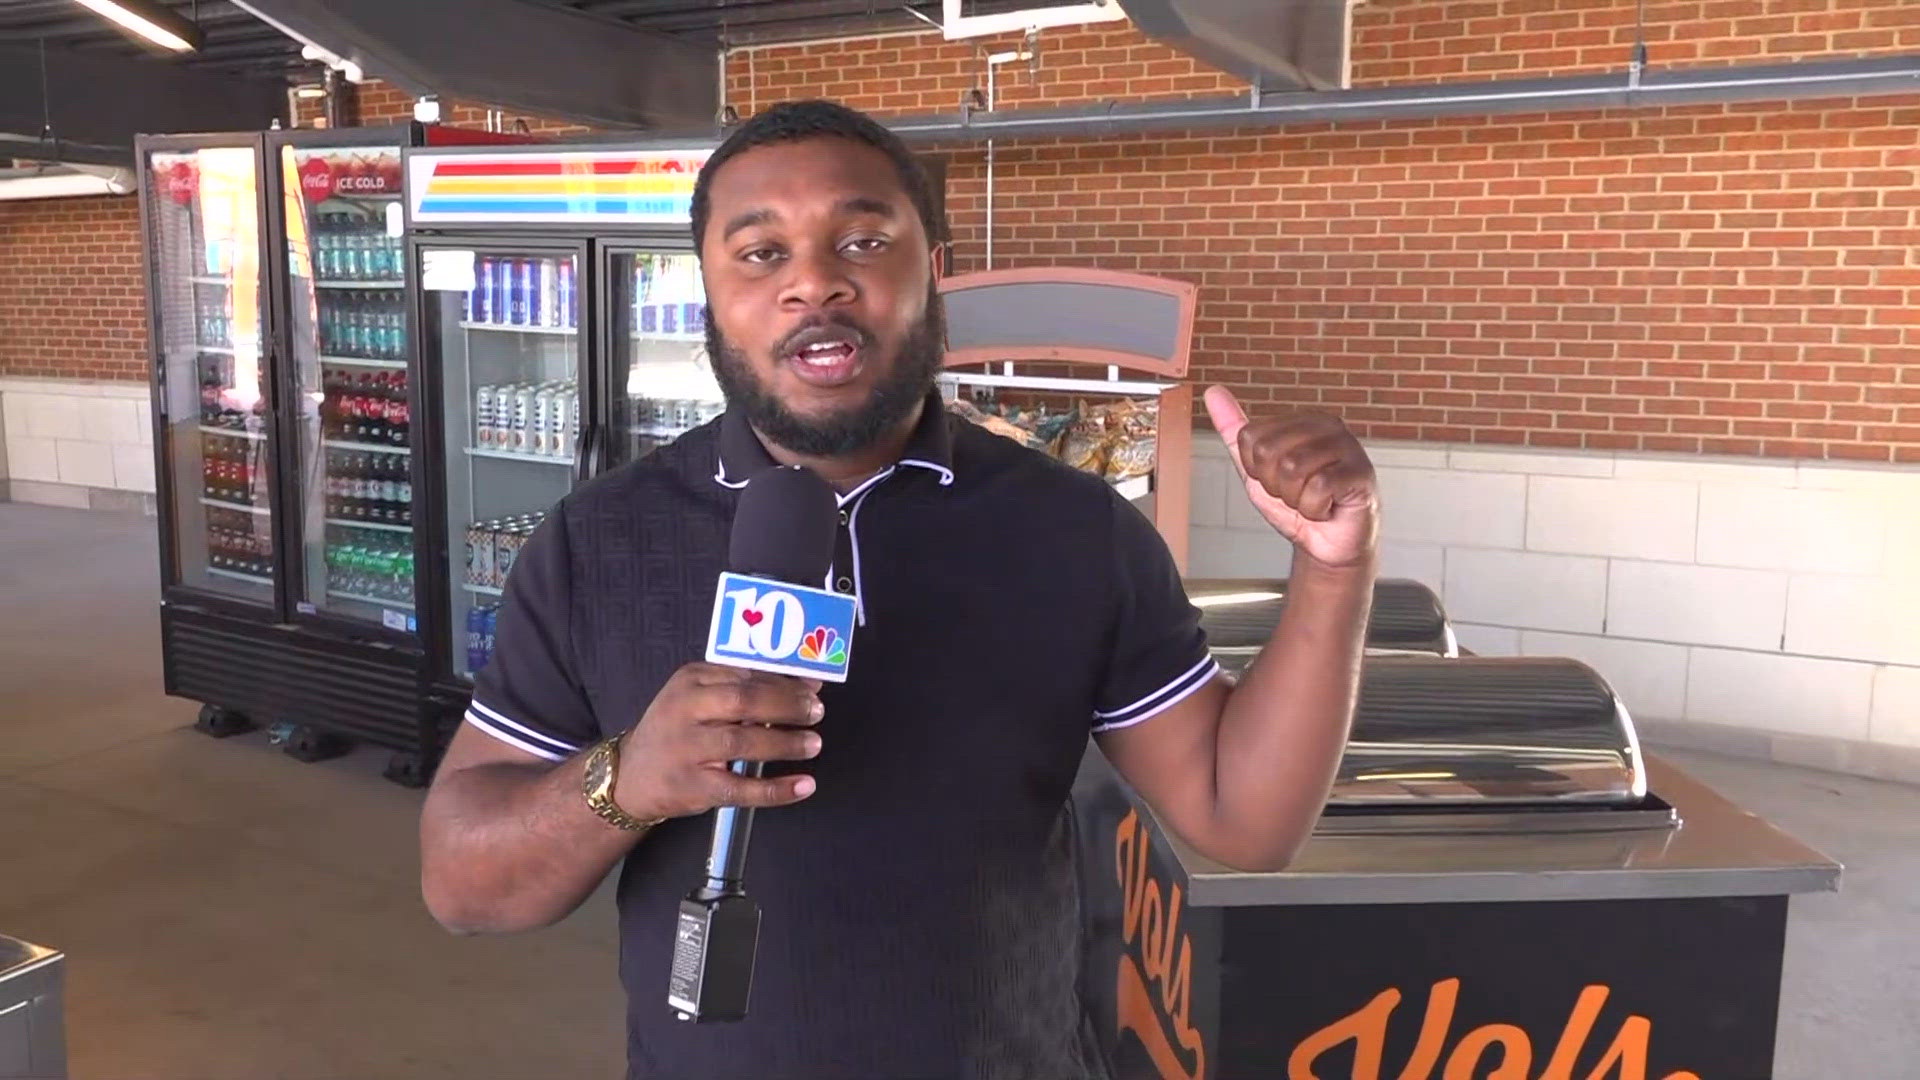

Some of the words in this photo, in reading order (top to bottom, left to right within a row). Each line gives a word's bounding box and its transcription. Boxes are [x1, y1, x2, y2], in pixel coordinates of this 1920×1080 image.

[336, 177, 353, 189] ICE
[355, 177, 385, 189] COLD
[717, 588, 804, 659] 10
[1115, 808, 1204, 1080] Vols
